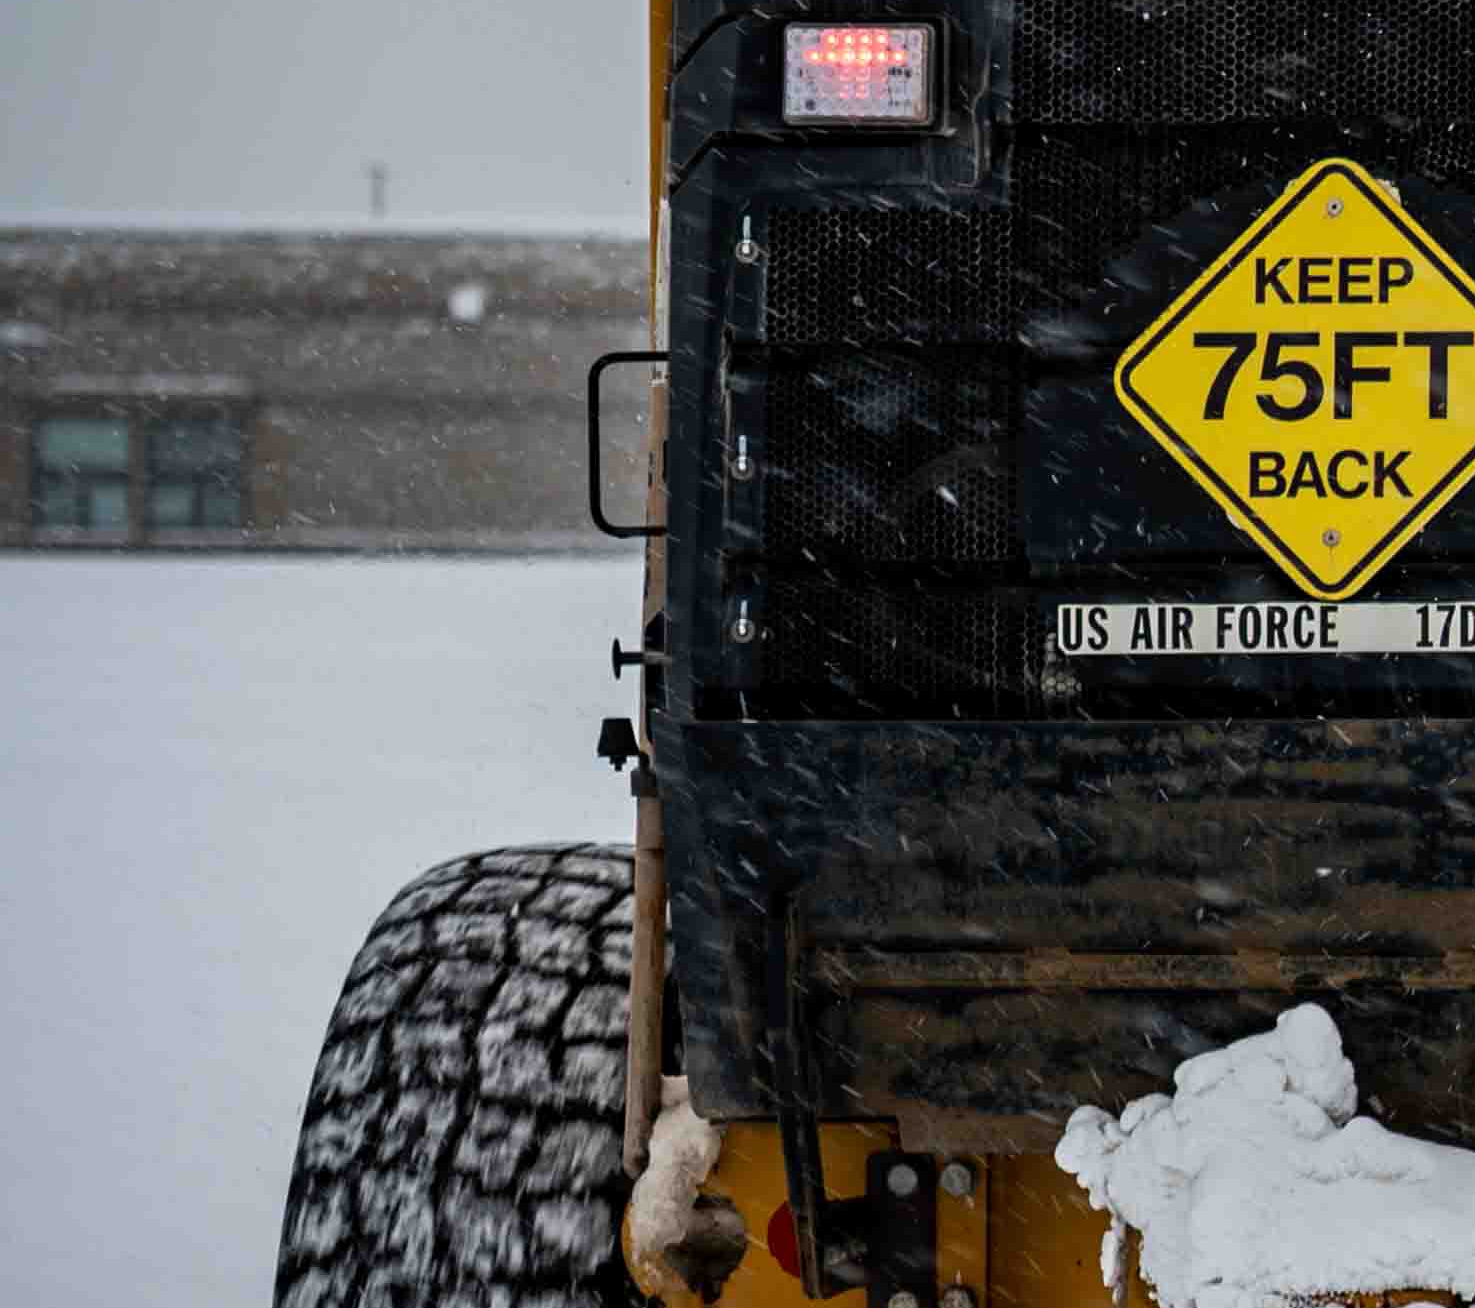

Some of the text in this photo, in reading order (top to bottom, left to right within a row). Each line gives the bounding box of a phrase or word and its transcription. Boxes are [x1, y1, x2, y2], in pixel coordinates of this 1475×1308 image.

[1254, 257, 1414, 305] KEEP
[1193, 330, 1475, 421] 75FT
[1248, 451, 1413, 499] BACK
[1061, 607, 1109, 651] US
[1130, 606, 1194, 651] AIR
[1216, 604, 1339, 650] FORCE
